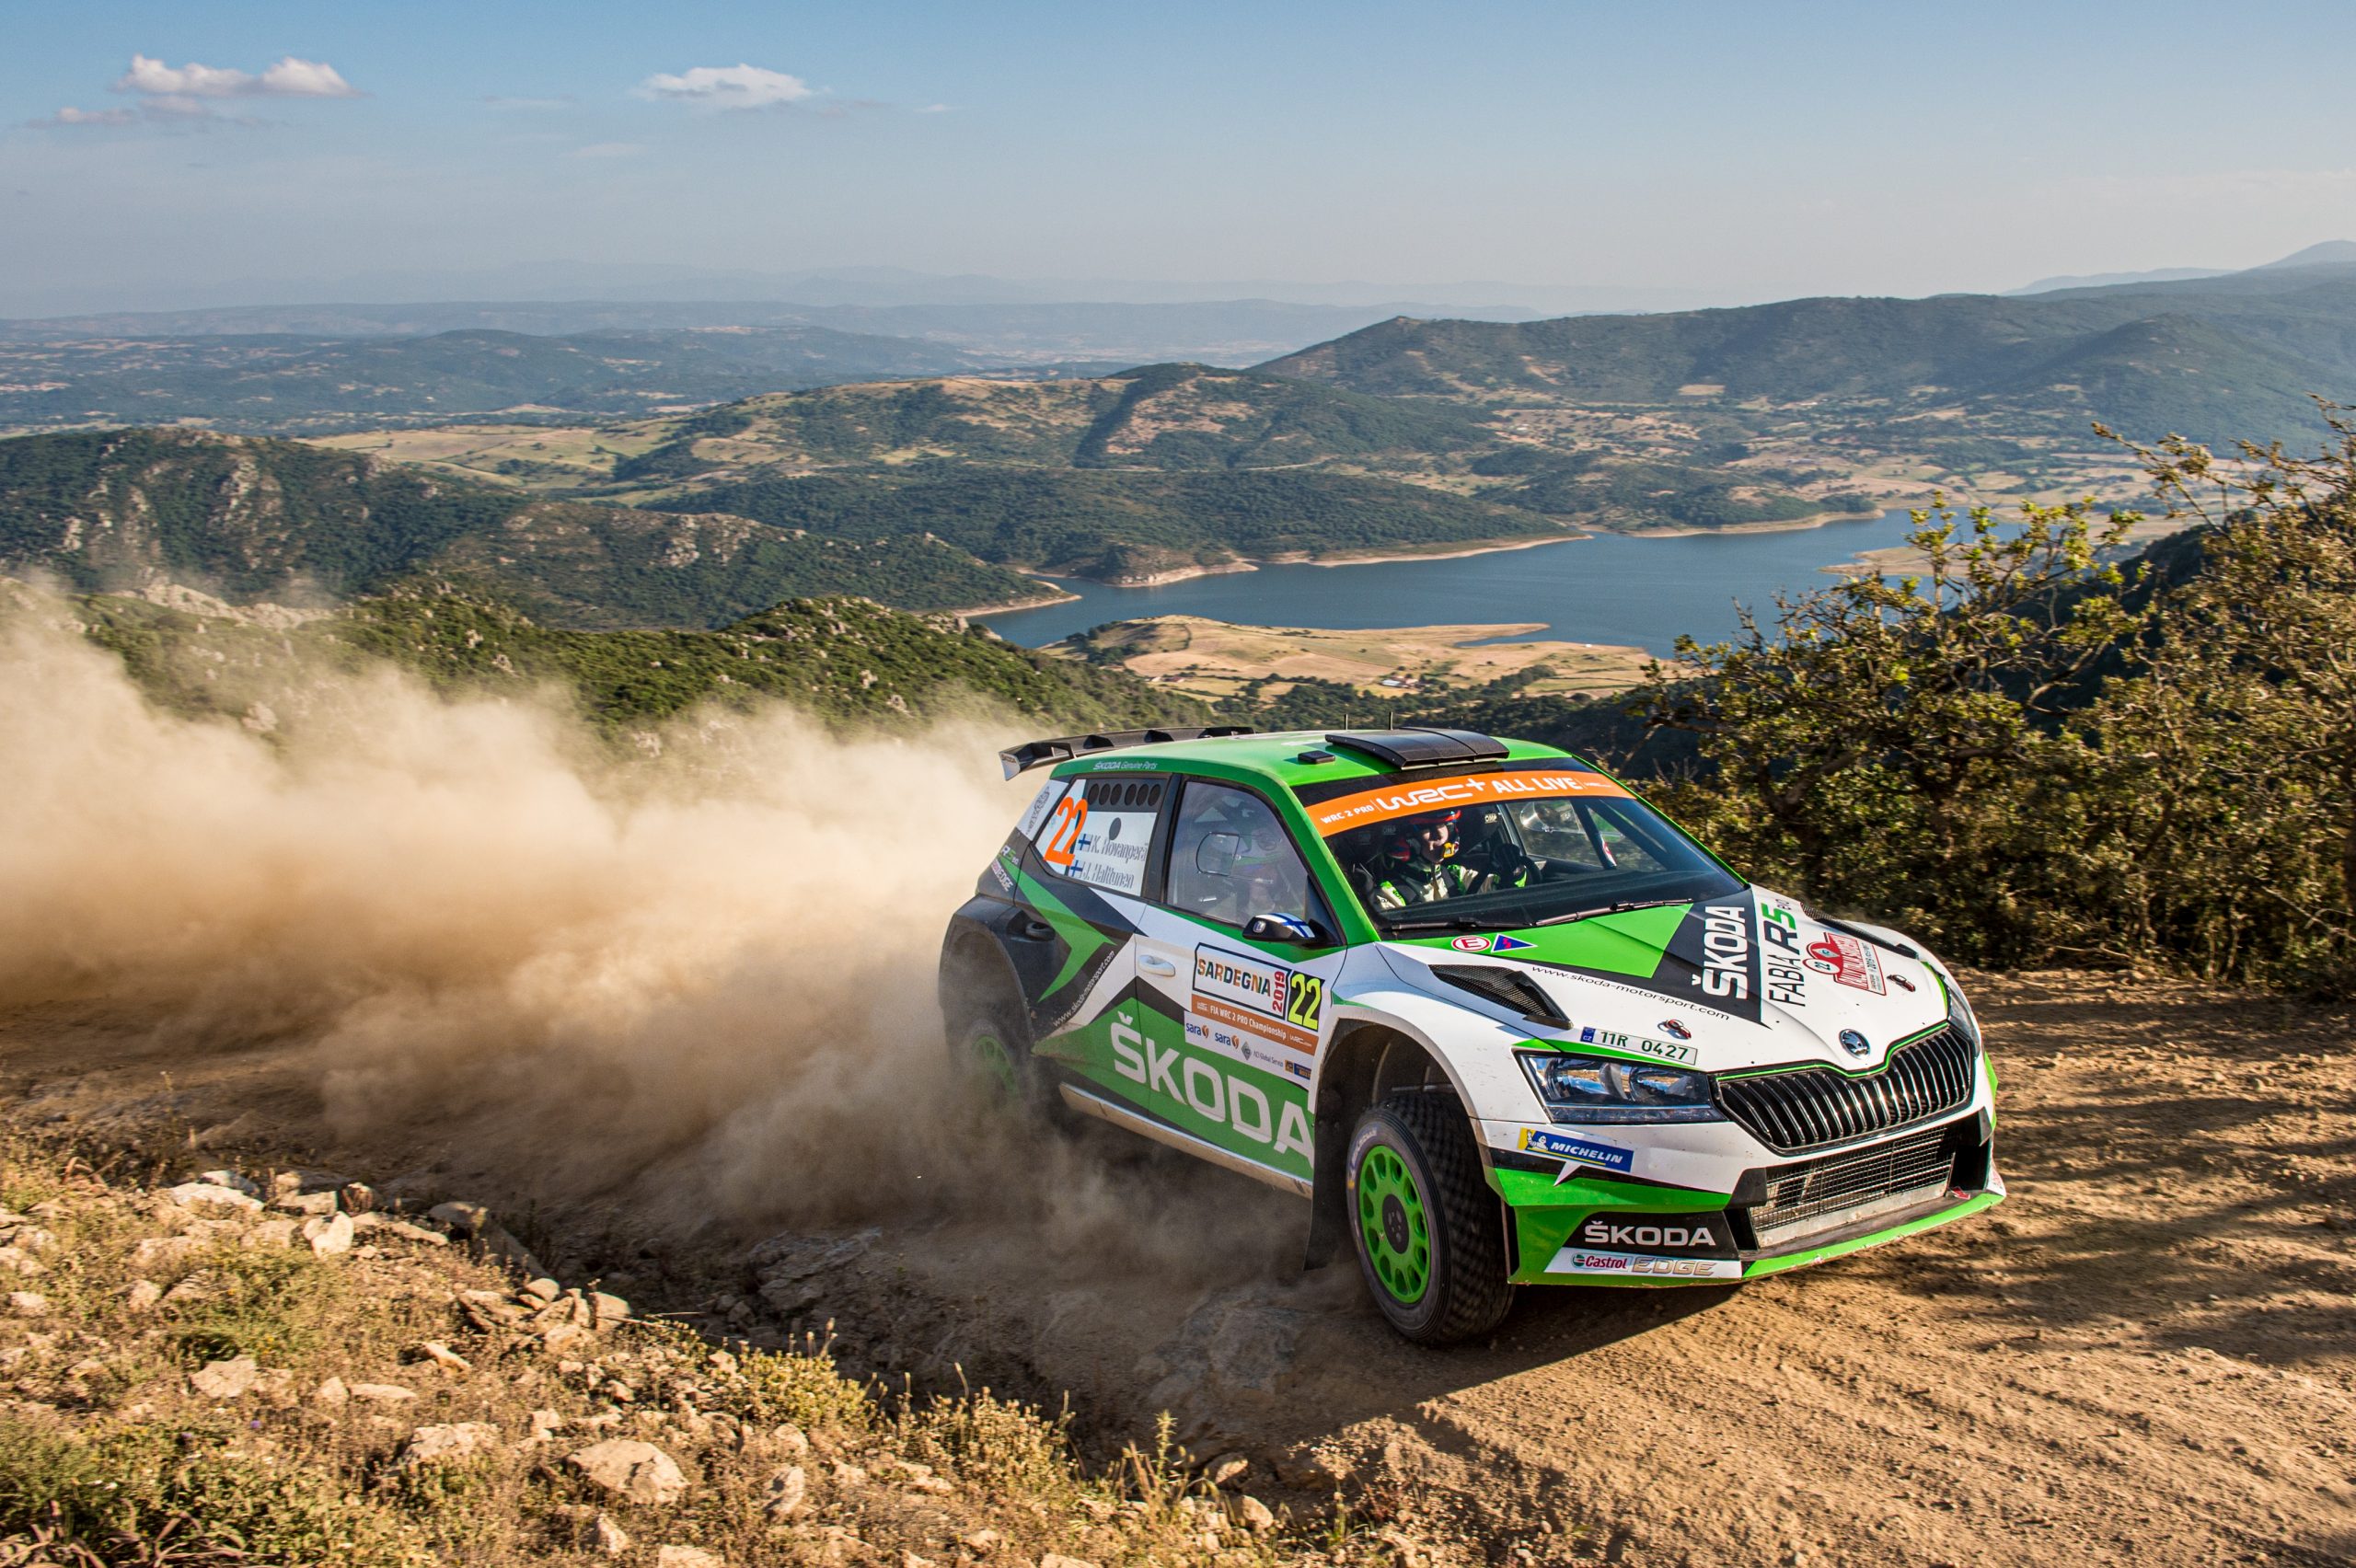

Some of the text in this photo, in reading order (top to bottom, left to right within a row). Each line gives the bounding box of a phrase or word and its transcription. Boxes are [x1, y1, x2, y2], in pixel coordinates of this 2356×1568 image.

[1493, 778, 1535, 794] ALL
[1535, 777, 1582, 791] LIVE
[1043, 796, 1088, 866] 22
[1321, 813, 1345, 824] WRC
[1354, 805, 1374, 814] PRO
[1761, 902, 1800, 956] R5
[1692, 905, 1748, 1000] ŠKODA
[1197, 958, 1271, 997] SARDEGNA
[1272, 971, 1286, 1013] 2019
[1532, 966, 1729, 1020] www.skoda-motorsport.com
[1767, 954, 1806, 1007] FABIA
[1288, 974, 1322, 1031] 22
[1186, 1022, 1201, 1036] sara
[1210, 1006, 1219, 1016] FIA
[1219, 1009, 1231, 1020] WRC
[1231, 1013, 1236, 1021] 2
[1237, 1014, 1248, 1025] PRO
[1249, 1019, 1287, 1040] Championship
[1215, 1032, 1231, 1046] sara
[1600, 1031, 1689, 1060] 11R 0427
[1110, 1011, 1314, 1169] ŠKODA
[1551, 1142, 1623, 1164] MICHELIN
[1585, 1220, 1716, 1247] ŠKODA
[1585, 1255, 1717, 1276] Castrol EDGE
